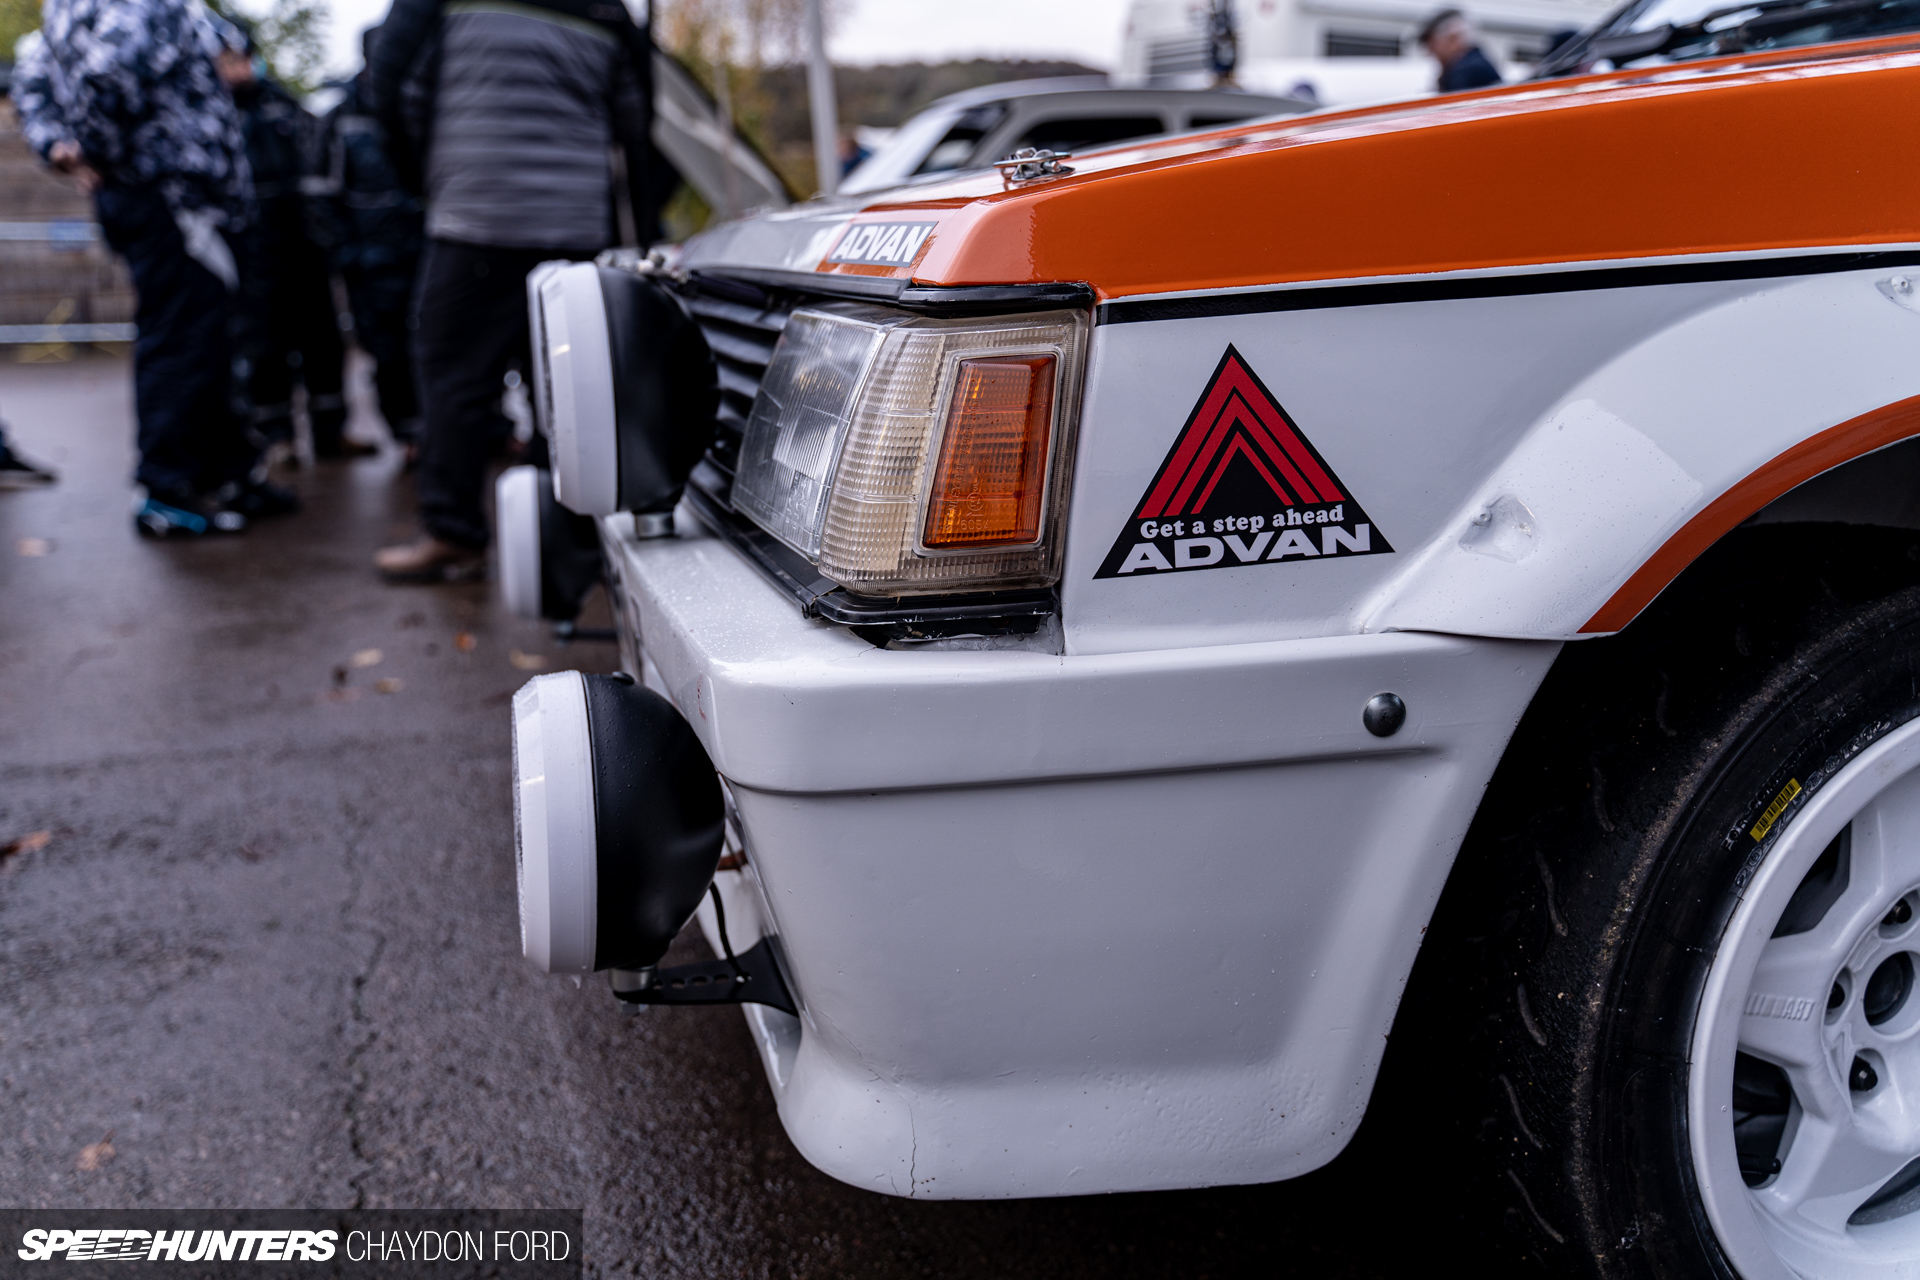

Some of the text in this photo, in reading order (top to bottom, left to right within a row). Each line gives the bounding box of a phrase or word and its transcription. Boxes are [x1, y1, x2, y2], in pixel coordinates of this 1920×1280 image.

[831, 225, 933, 263] ADVAN
[1140, 504, 1345, 539] Get a step ahead
[1117, 523, 1371, 574] ADVAN
